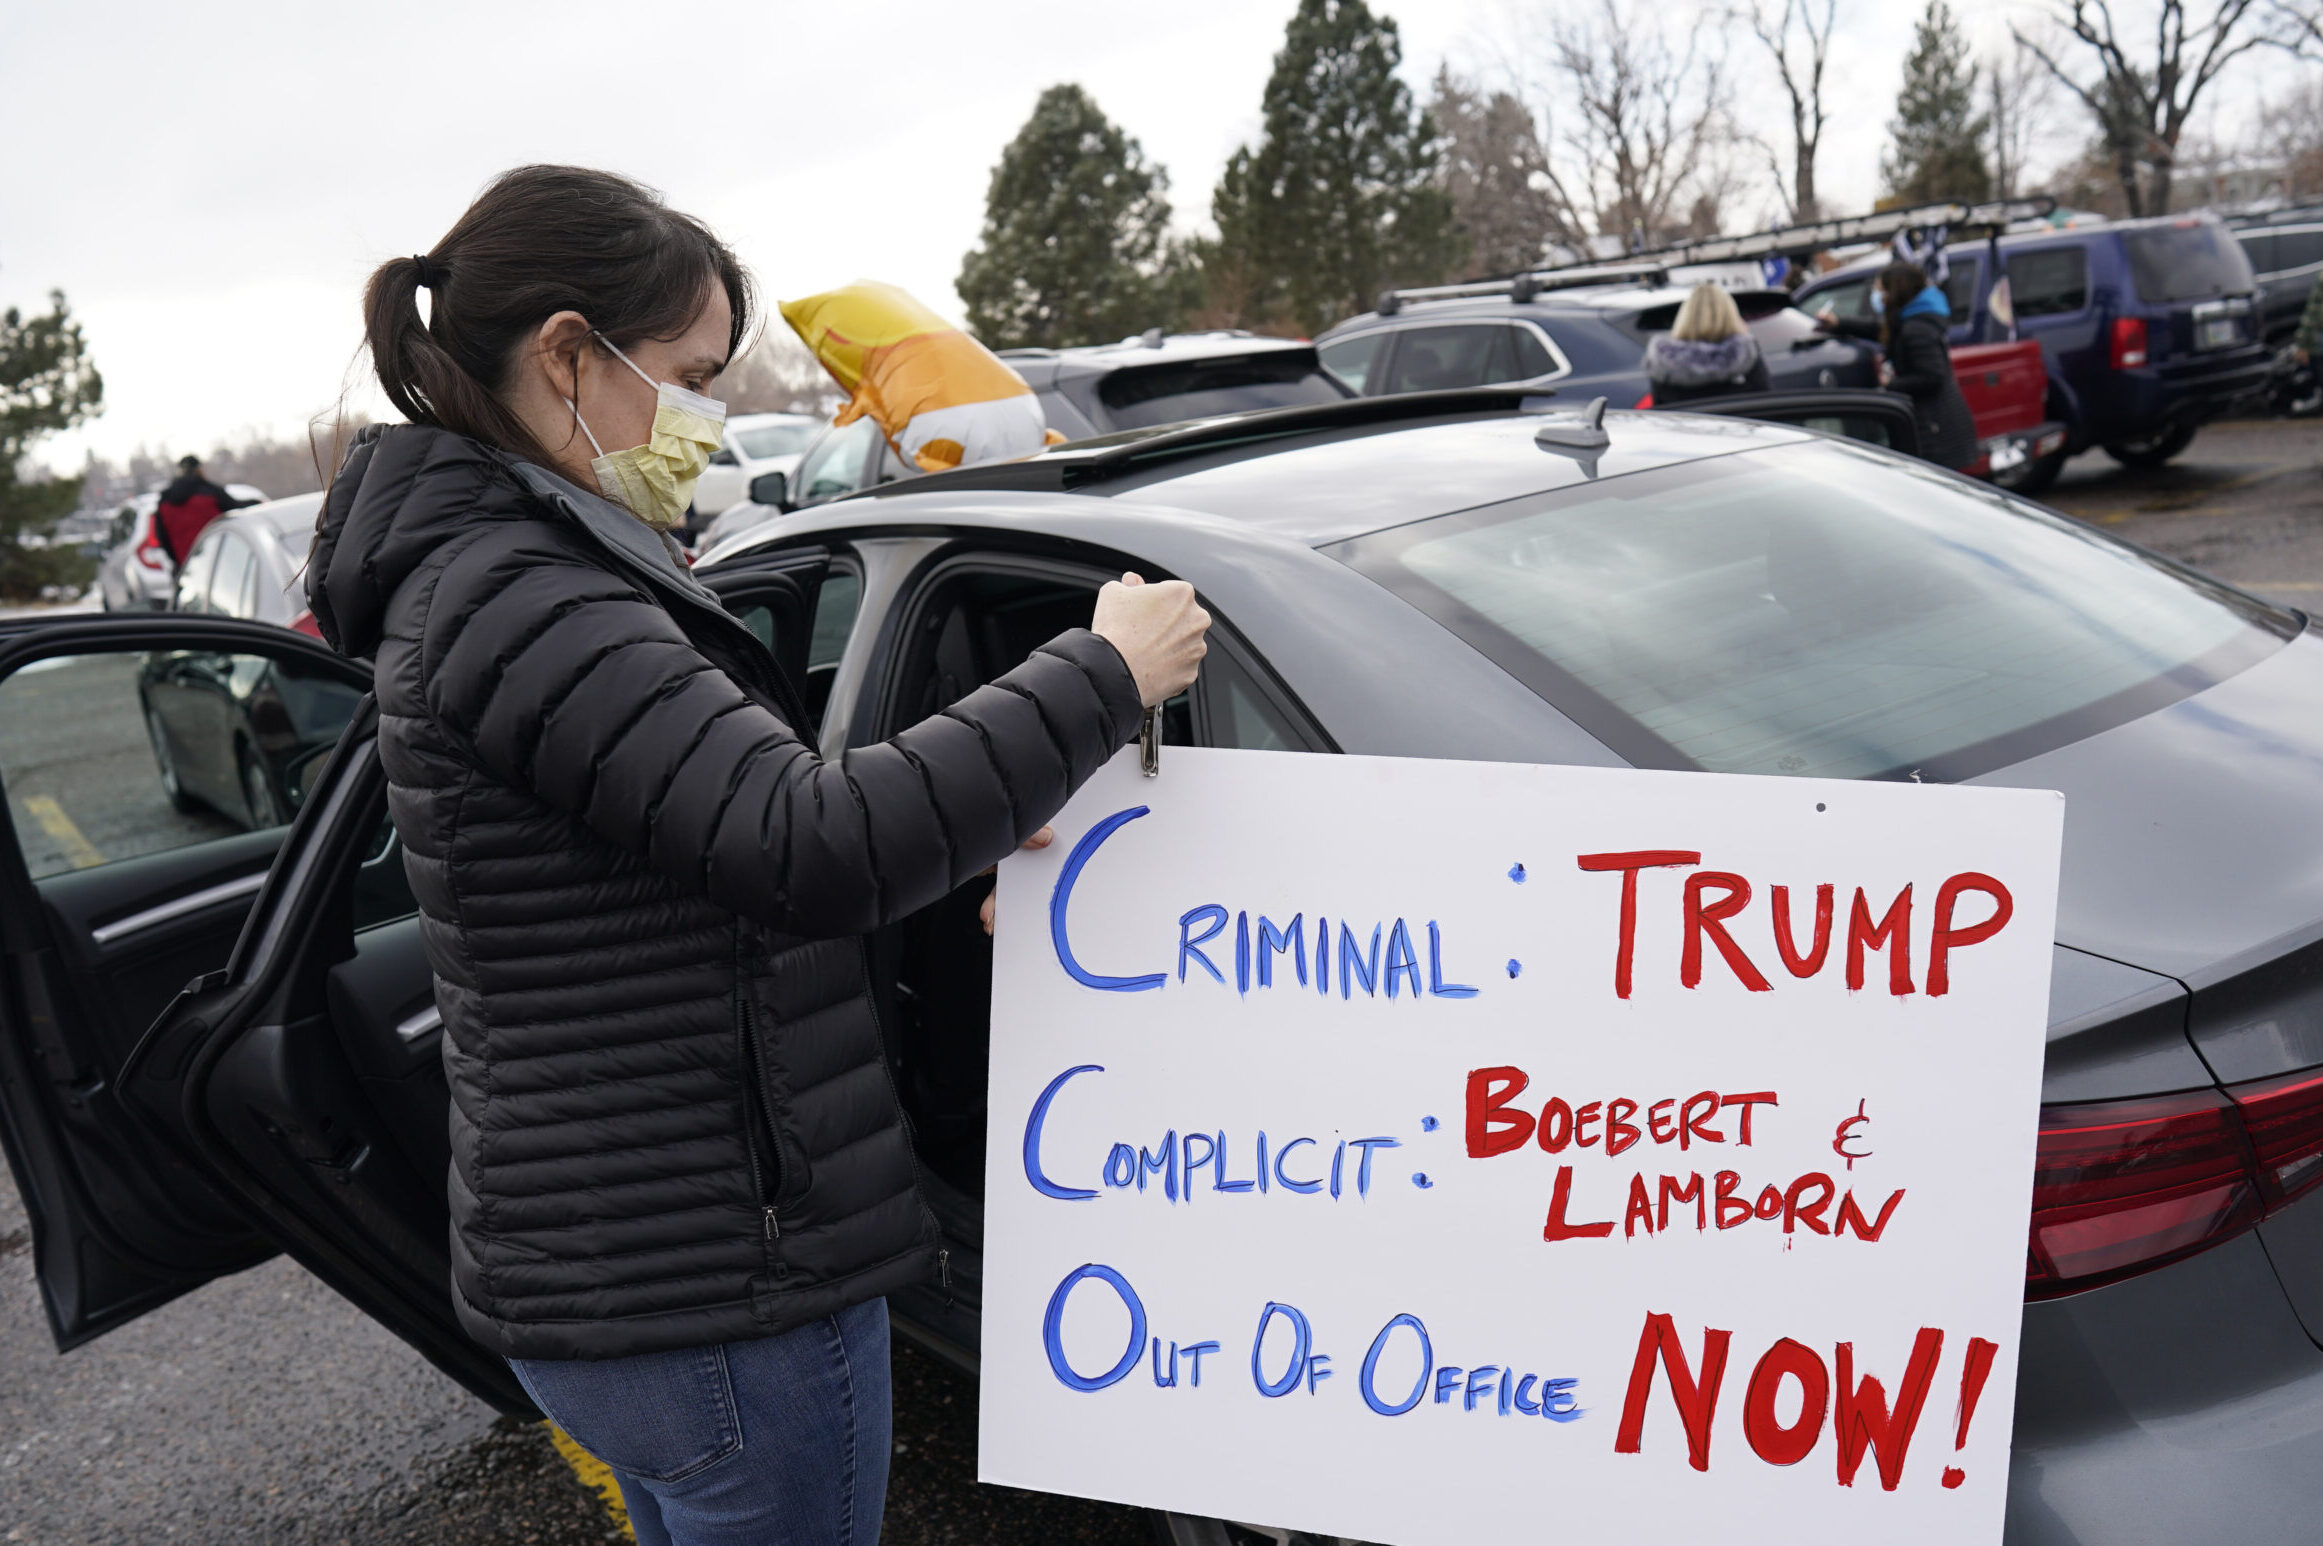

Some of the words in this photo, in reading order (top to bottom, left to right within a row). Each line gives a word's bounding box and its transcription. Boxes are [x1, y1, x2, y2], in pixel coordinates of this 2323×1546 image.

[1577, 849, 2014, 1001] TRUMP
[1465, 1064, 1779, 1159] BOEBERT
[1832, 1098, 1874, 1171] &
[1542, 1164, 1907, 1252] LAMBORN
[1042, 1262, 1222, 1394] OUT
[1250, 1300, 1335, 1399] OF
[1358, 1312, 1586, 1425] OFFICE
[1614, 1309, 2001, 1492] NOW!
